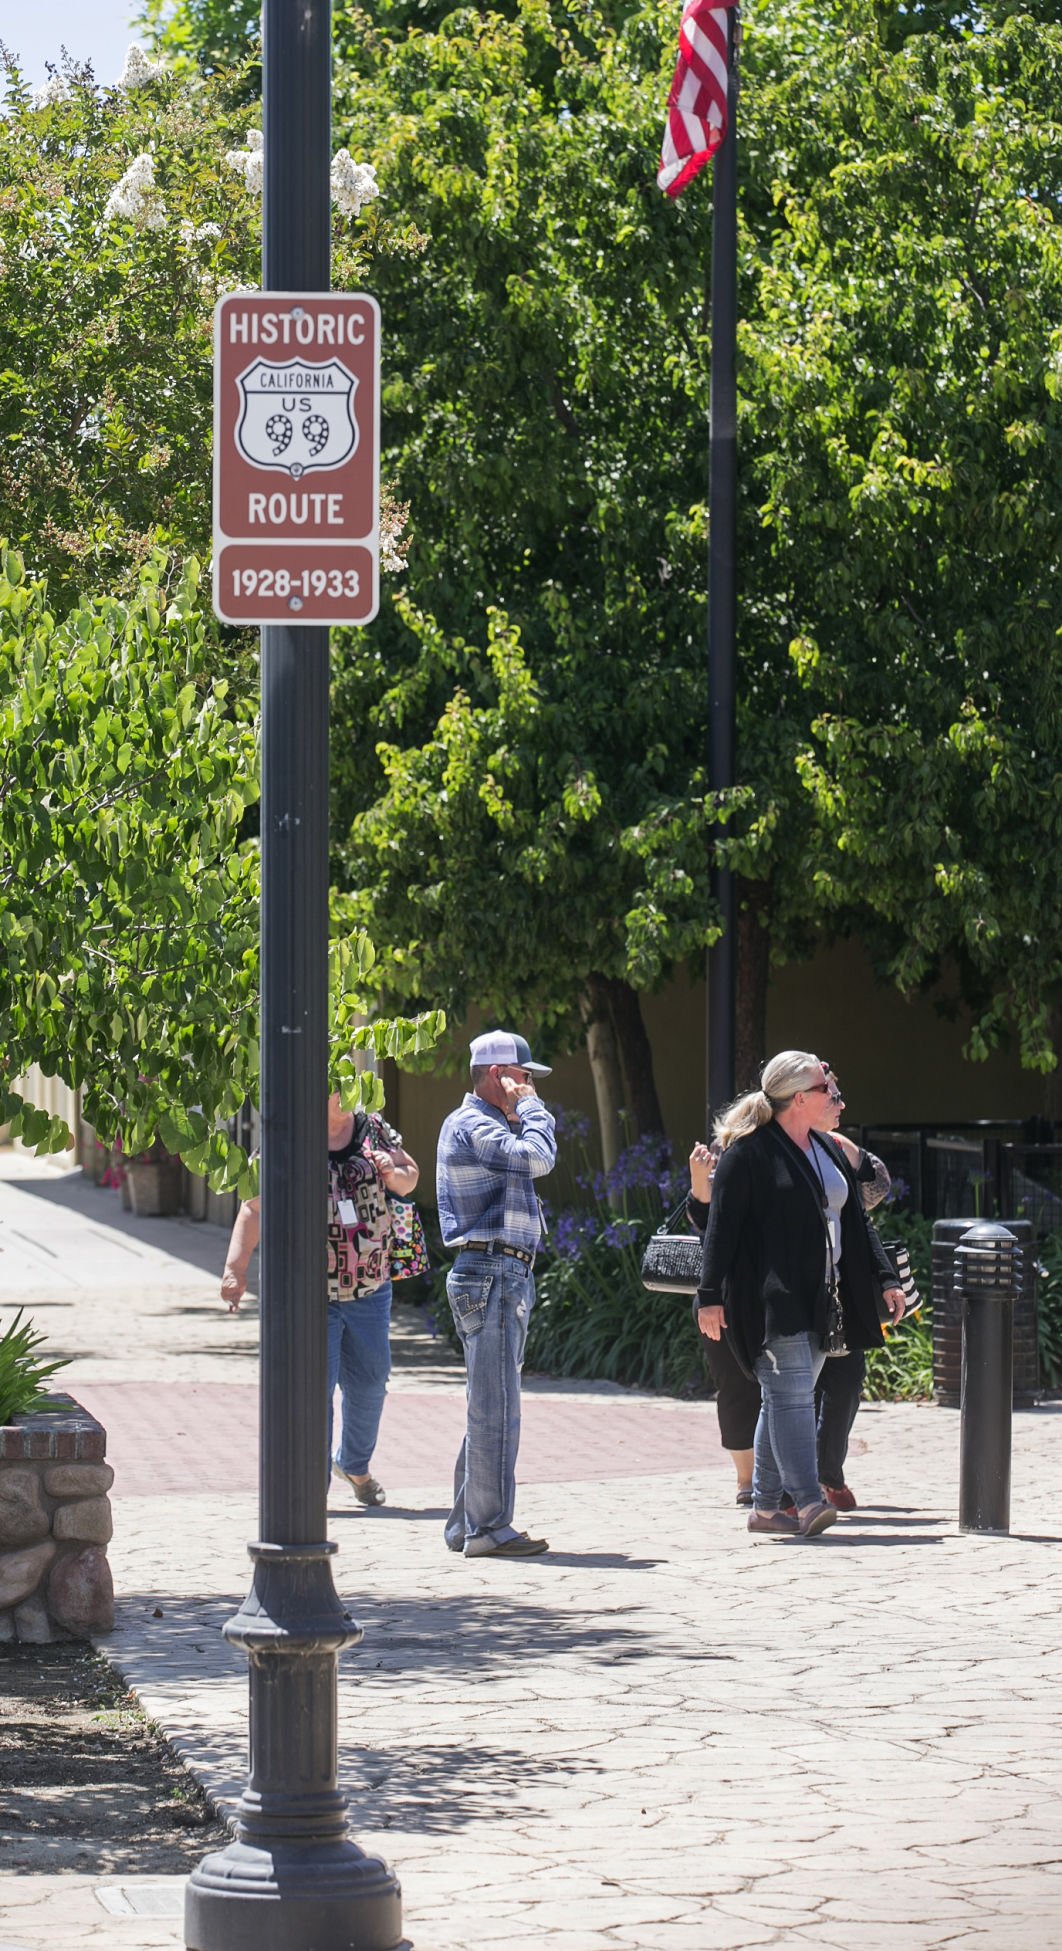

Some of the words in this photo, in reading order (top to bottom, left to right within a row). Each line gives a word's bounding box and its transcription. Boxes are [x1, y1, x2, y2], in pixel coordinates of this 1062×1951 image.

[229, 312, 366, 345] HISTORIC
[260, 372, 334, 389] CALIFORNIA
[281, 397, 312, 412] US
[265, 414, 330, 457] 99
[248, 492, 345, 525] ROUTE
[232, 568, 360, 598] 1928-1933
